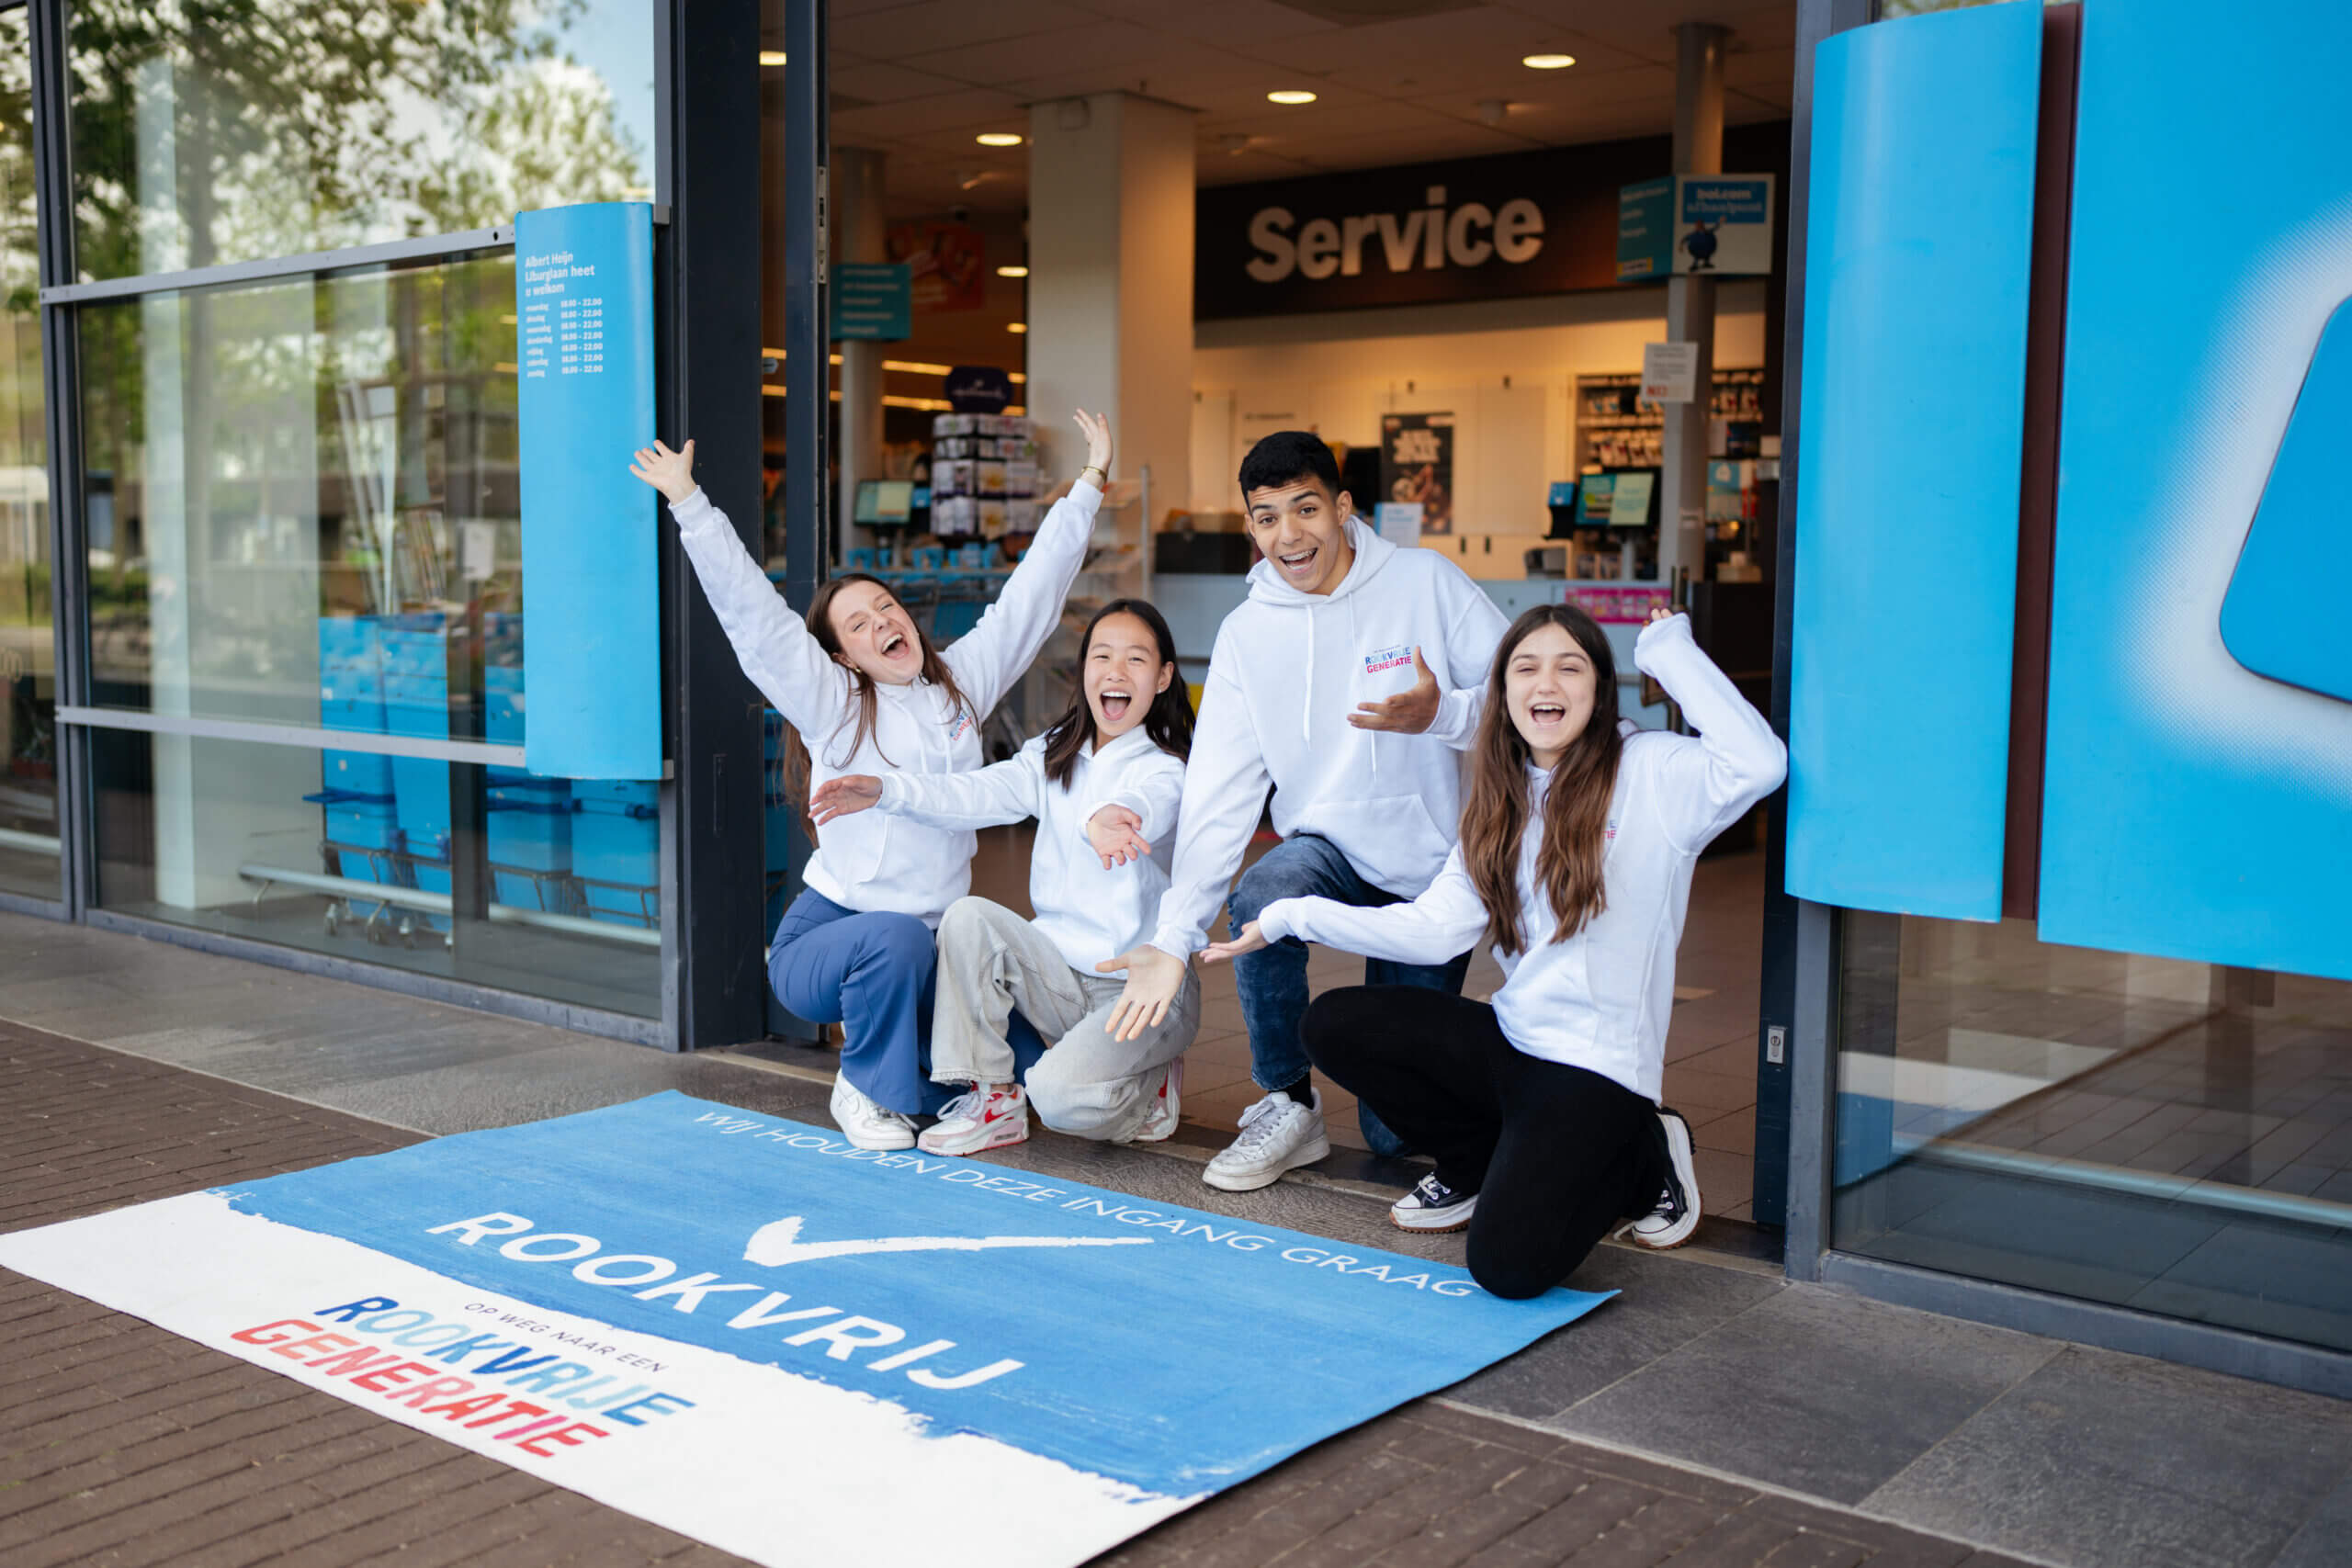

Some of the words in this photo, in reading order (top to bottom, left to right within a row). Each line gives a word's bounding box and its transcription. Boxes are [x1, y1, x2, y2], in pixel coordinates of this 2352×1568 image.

[1245, 186, 1544, 282] Service
[525, 254, 549, 267] Albert
[551, 251, 573, 265] Heijn
[571, 264, 595, 276] heet
[526, 288, 531, 297] u
[533, 283, 564, 296] welkom
[582, 298, 602, 306] 22.00
[582, 309, 603, 317] 22.00
[582, 320, 603, 328] 22.00
[583, 331, 603, 340] 22.00
[583, 343, 603, 351] 22.00
[583, 354, 603, 362] 22.00
[583, 365, 603, 373] 22.00
[1365, 647, 1411, 665] RKVRE
[1366, 655, 1412, 673] GENERATIE
[694, 1111, 764, 1134] WIJ
[753, 1128, 948, 1175] HOUDEN
[939, 1168, 1069, 1201] DEZE
[1060, 1197, 1275, 1252] INGANG
[1281, 1247, 1482, 1297] GRAAG
[425, 1211, 1025, 1390] ROOKVRIJ
[464, 1303, 498, 1314] OP
[499, 1314, 550, 1333] WEG
[549, 1331, 616, 1355] NAAR
[616, 1352, 669, 1373] EEN
[313, 1295, 697, 1427] ROOKVRIJE
[230, 1319, 611, 1459] GENERATIE
